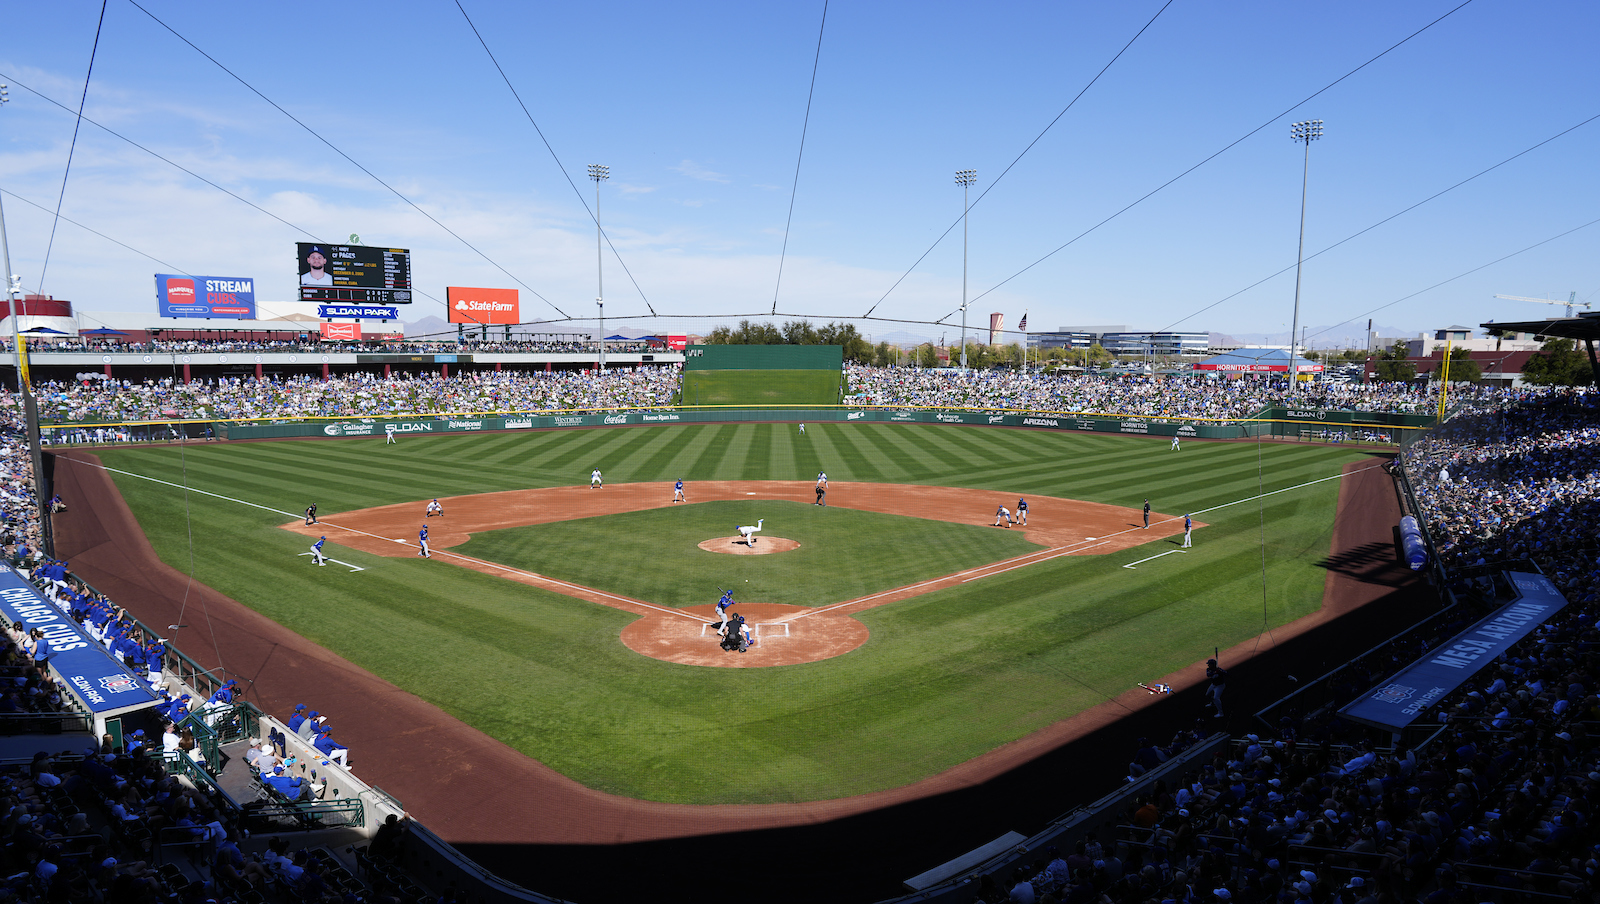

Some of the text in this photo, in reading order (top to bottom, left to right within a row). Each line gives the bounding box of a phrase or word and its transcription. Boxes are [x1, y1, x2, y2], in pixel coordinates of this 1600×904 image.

[206, 280, 251, 293] STREAM
[207, 293, 240, 304] CUBS.
[1023, 418, 1058, 426] ARIZONA
[0, 588, 58, 623] CHICAGO
[37, 624, 88, 651] CUBS
[1431, 603, 1549, 669] MESA ARIZONA
